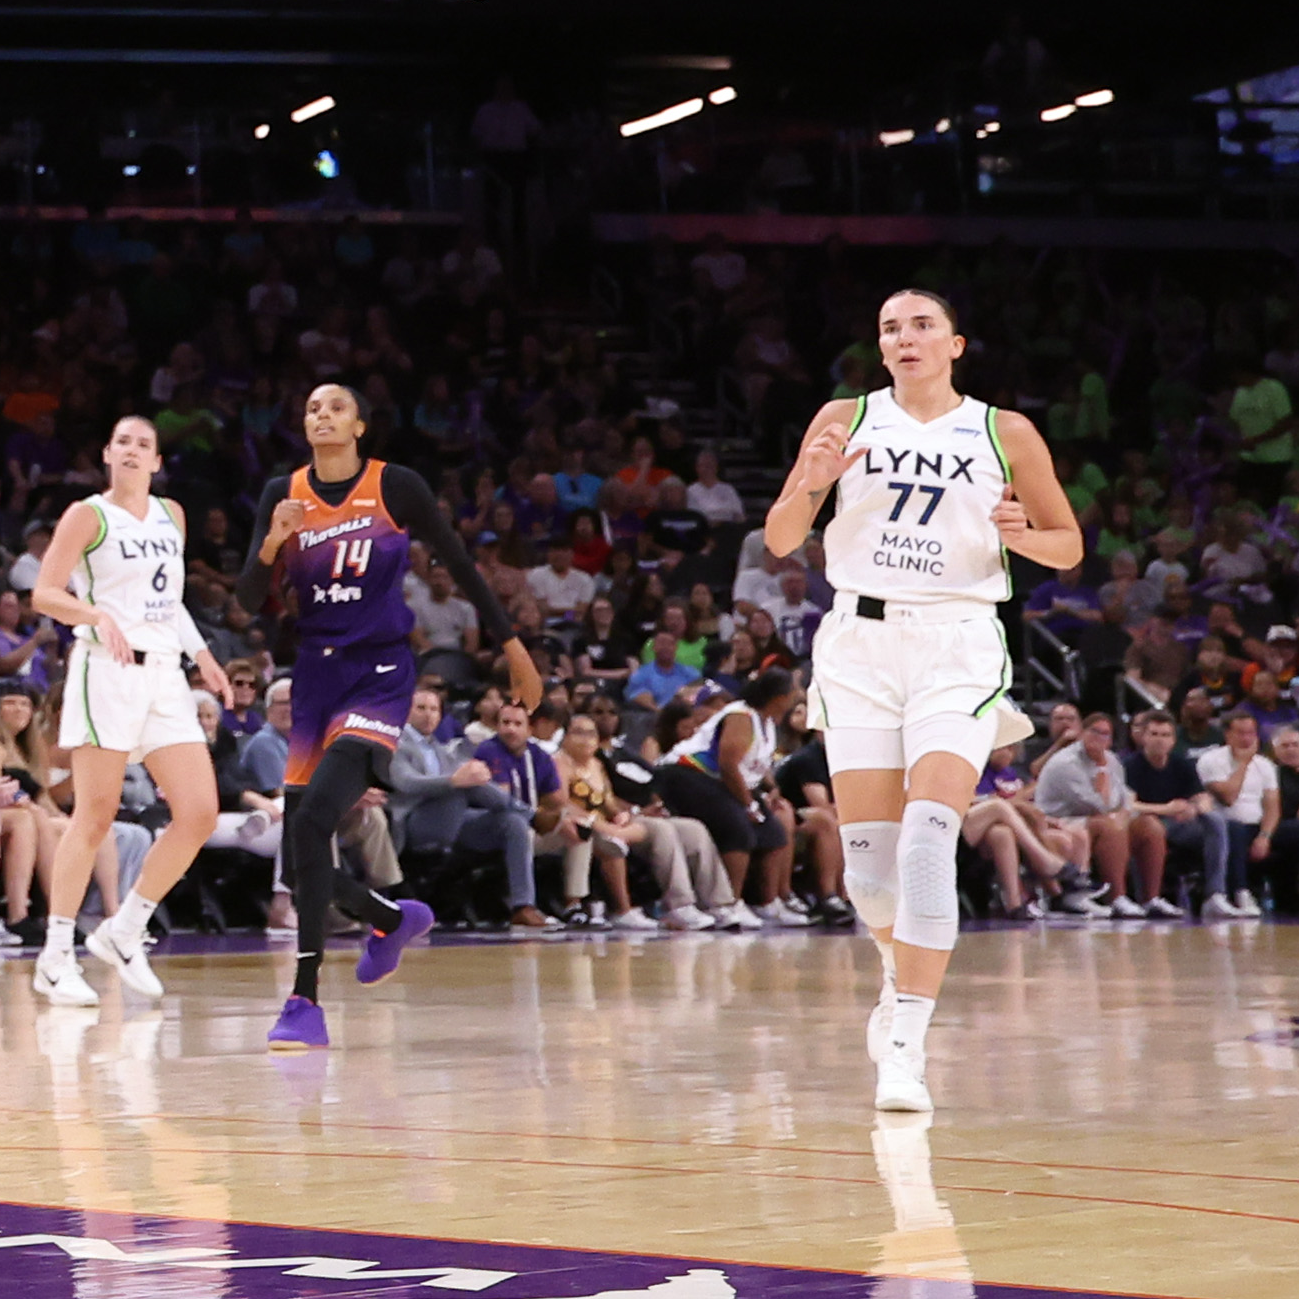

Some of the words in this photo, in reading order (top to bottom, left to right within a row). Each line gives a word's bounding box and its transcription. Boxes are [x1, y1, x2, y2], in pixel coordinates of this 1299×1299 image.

[865, 448, 975, 485] LYNX
[888, 482, 946, 526] 77
[299, 516, 372, 551] Phoenix
[881, 533, 942, 555] MAYO
[332, 538, 372, 578] 14
[873, 551, 945, 576] CLINIC
[152, 563, 167, 593] 6
